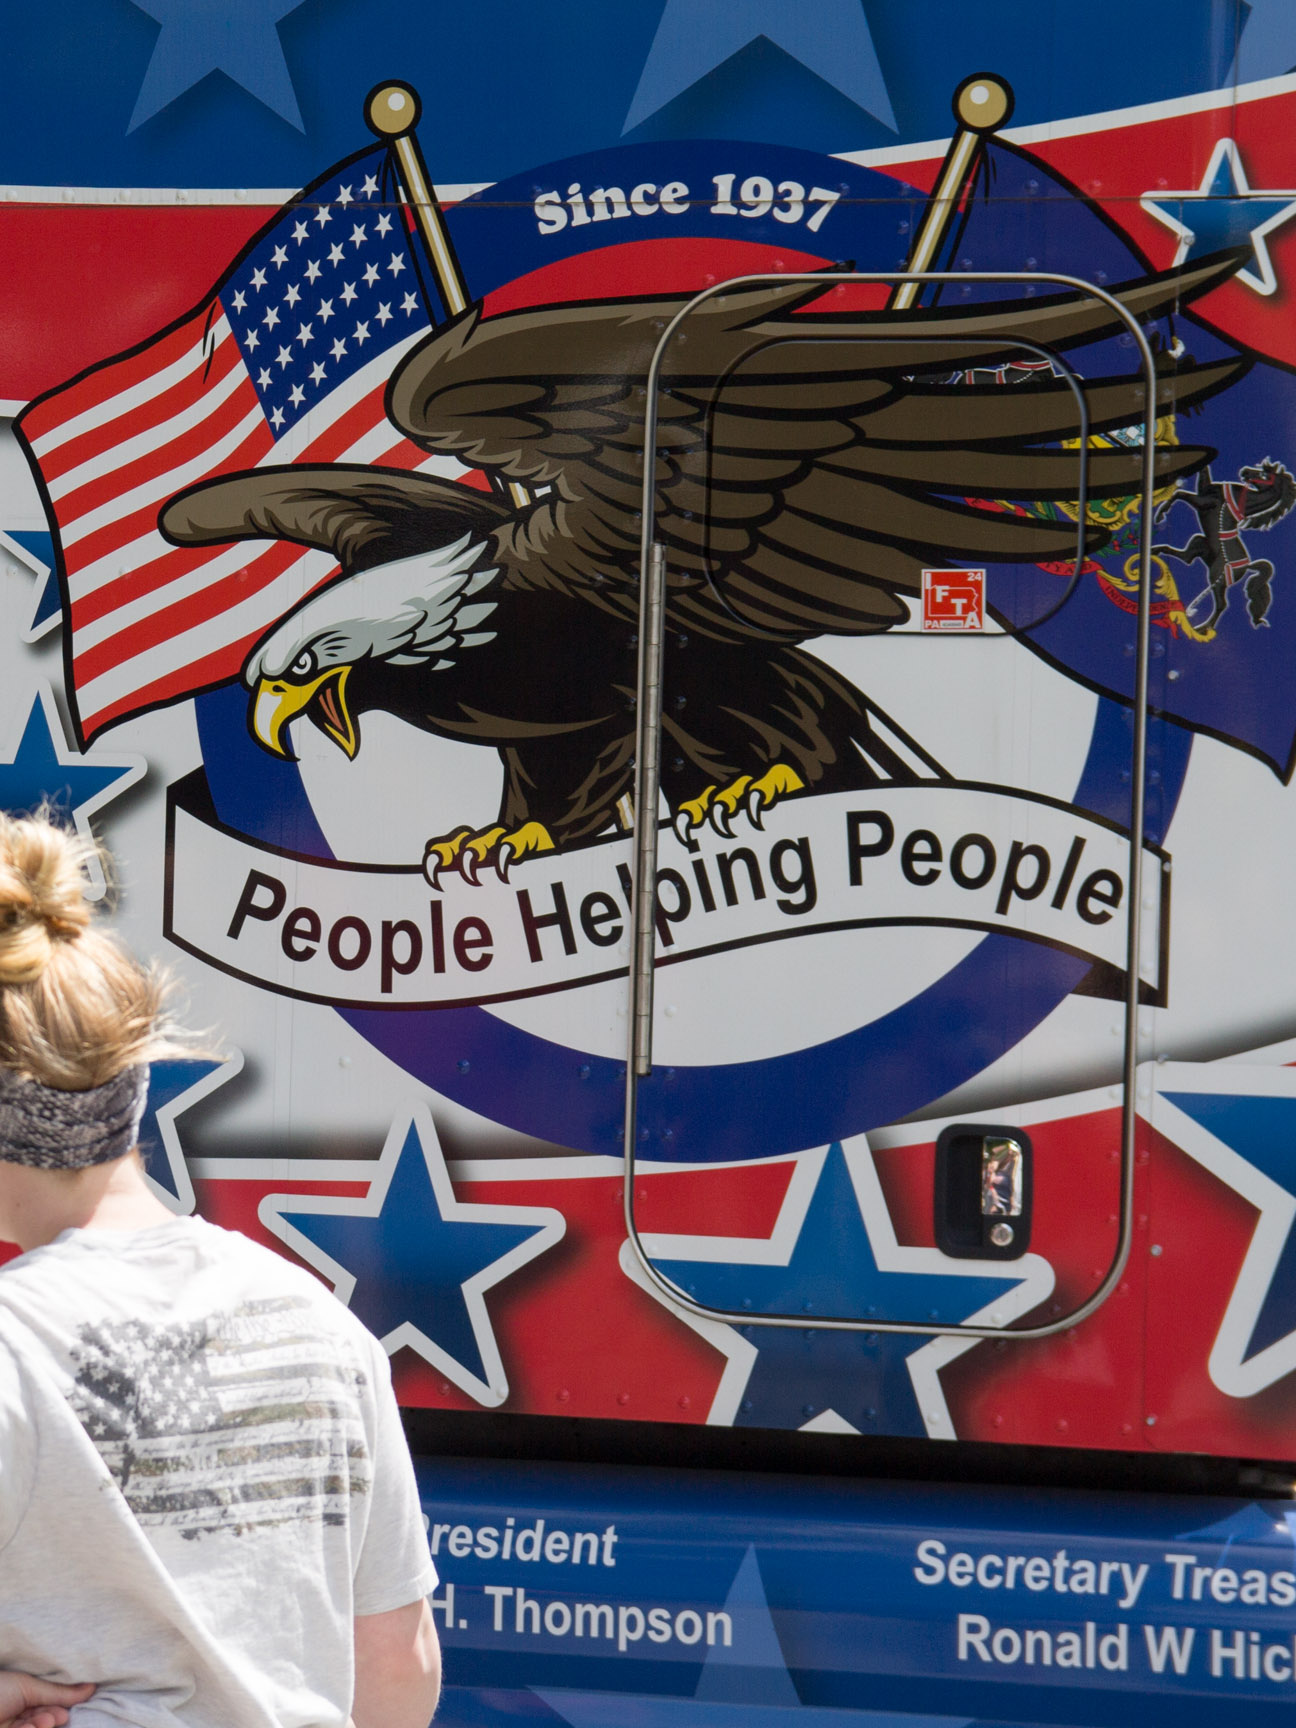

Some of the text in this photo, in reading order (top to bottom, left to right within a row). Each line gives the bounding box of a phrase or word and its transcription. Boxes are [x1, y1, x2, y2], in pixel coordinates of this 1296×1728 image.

[534, 173, 842, 235] Since 1937
[226, 868, 495, 994] People
[846, 810, 1124, 925] People
[914, 1539, 1149, 1610] Secretary
[484, 1585, 733, 1652] Thompson
[957, 1613, 1296, 1682] Ronald W Hic
